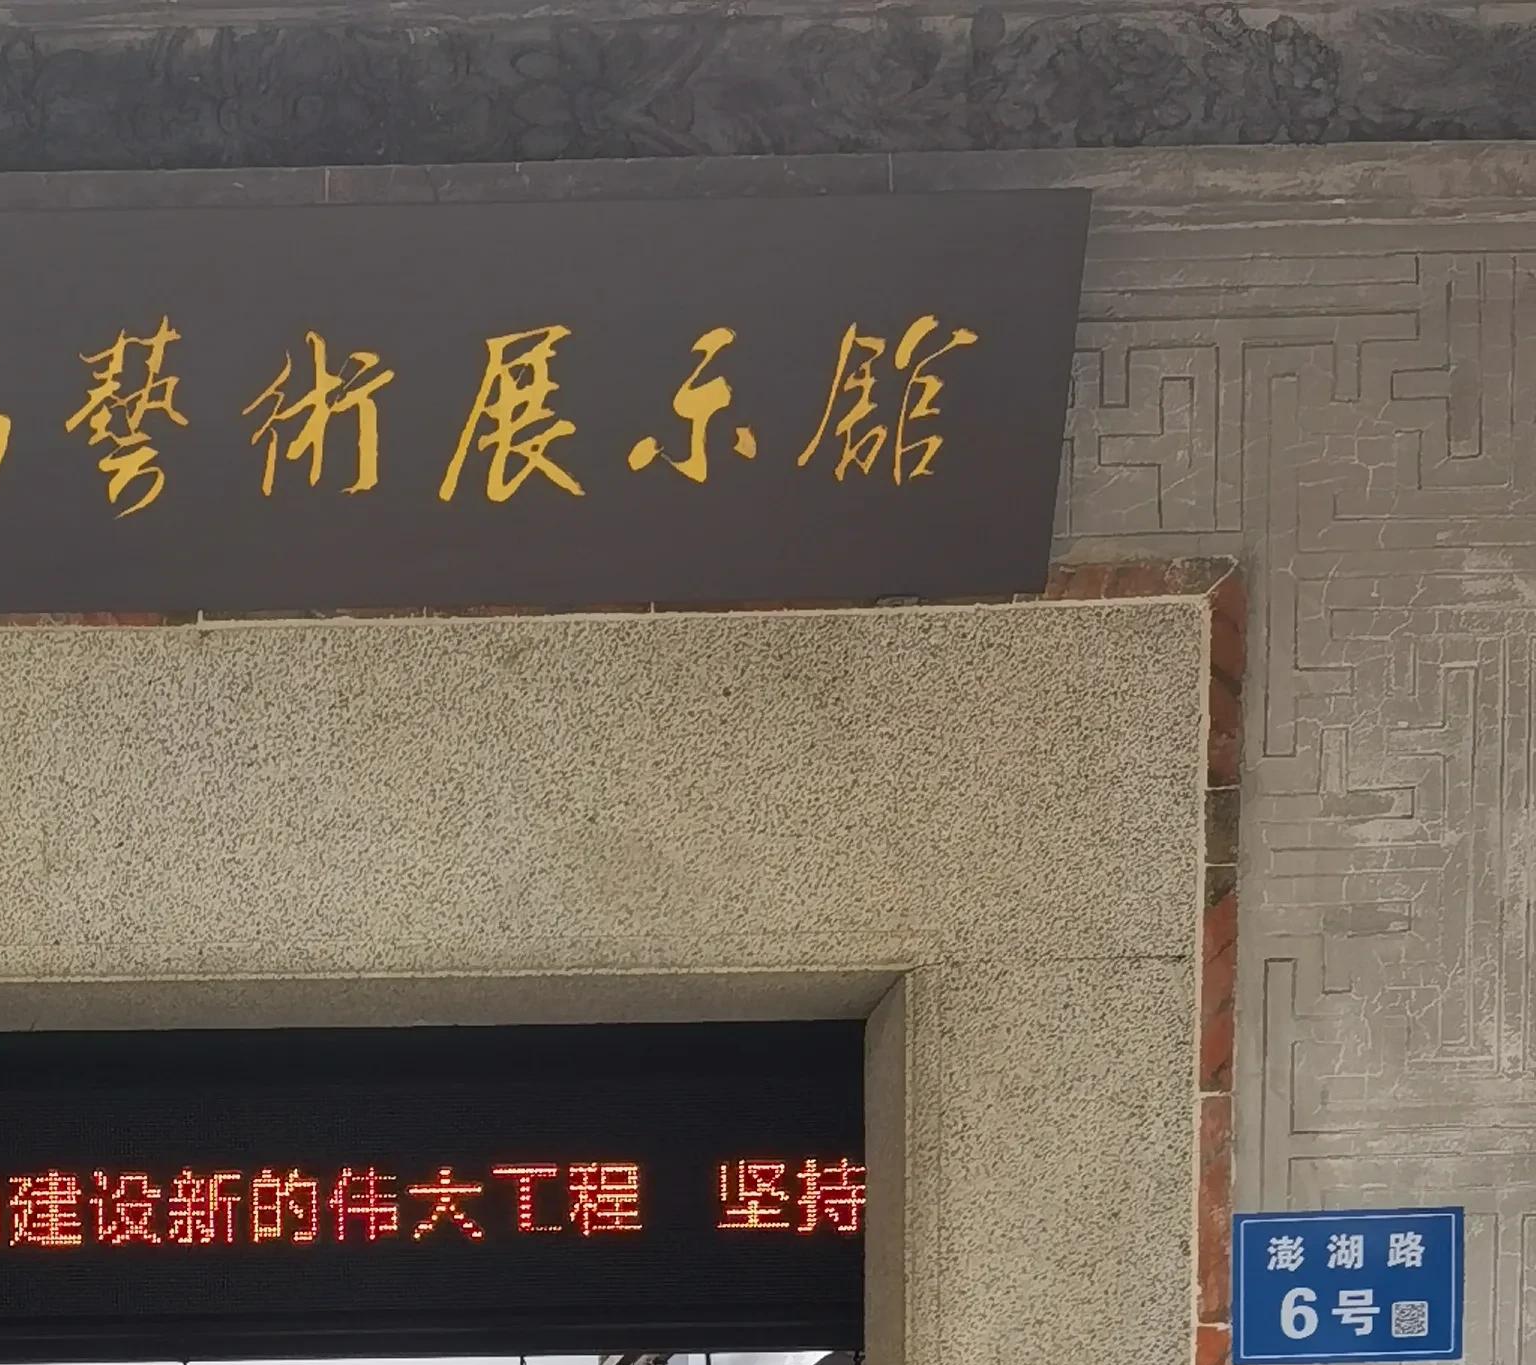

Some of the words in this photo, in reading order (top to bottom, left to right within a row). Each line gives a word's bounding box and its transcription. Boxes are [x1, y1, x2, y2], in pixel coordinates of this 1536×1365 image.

[716, 1158, 865, 1234] 坚持
[1266, 1231, 1426, 1272] 澎湖路
[1280, 1287, 1381, 1339] 6号
